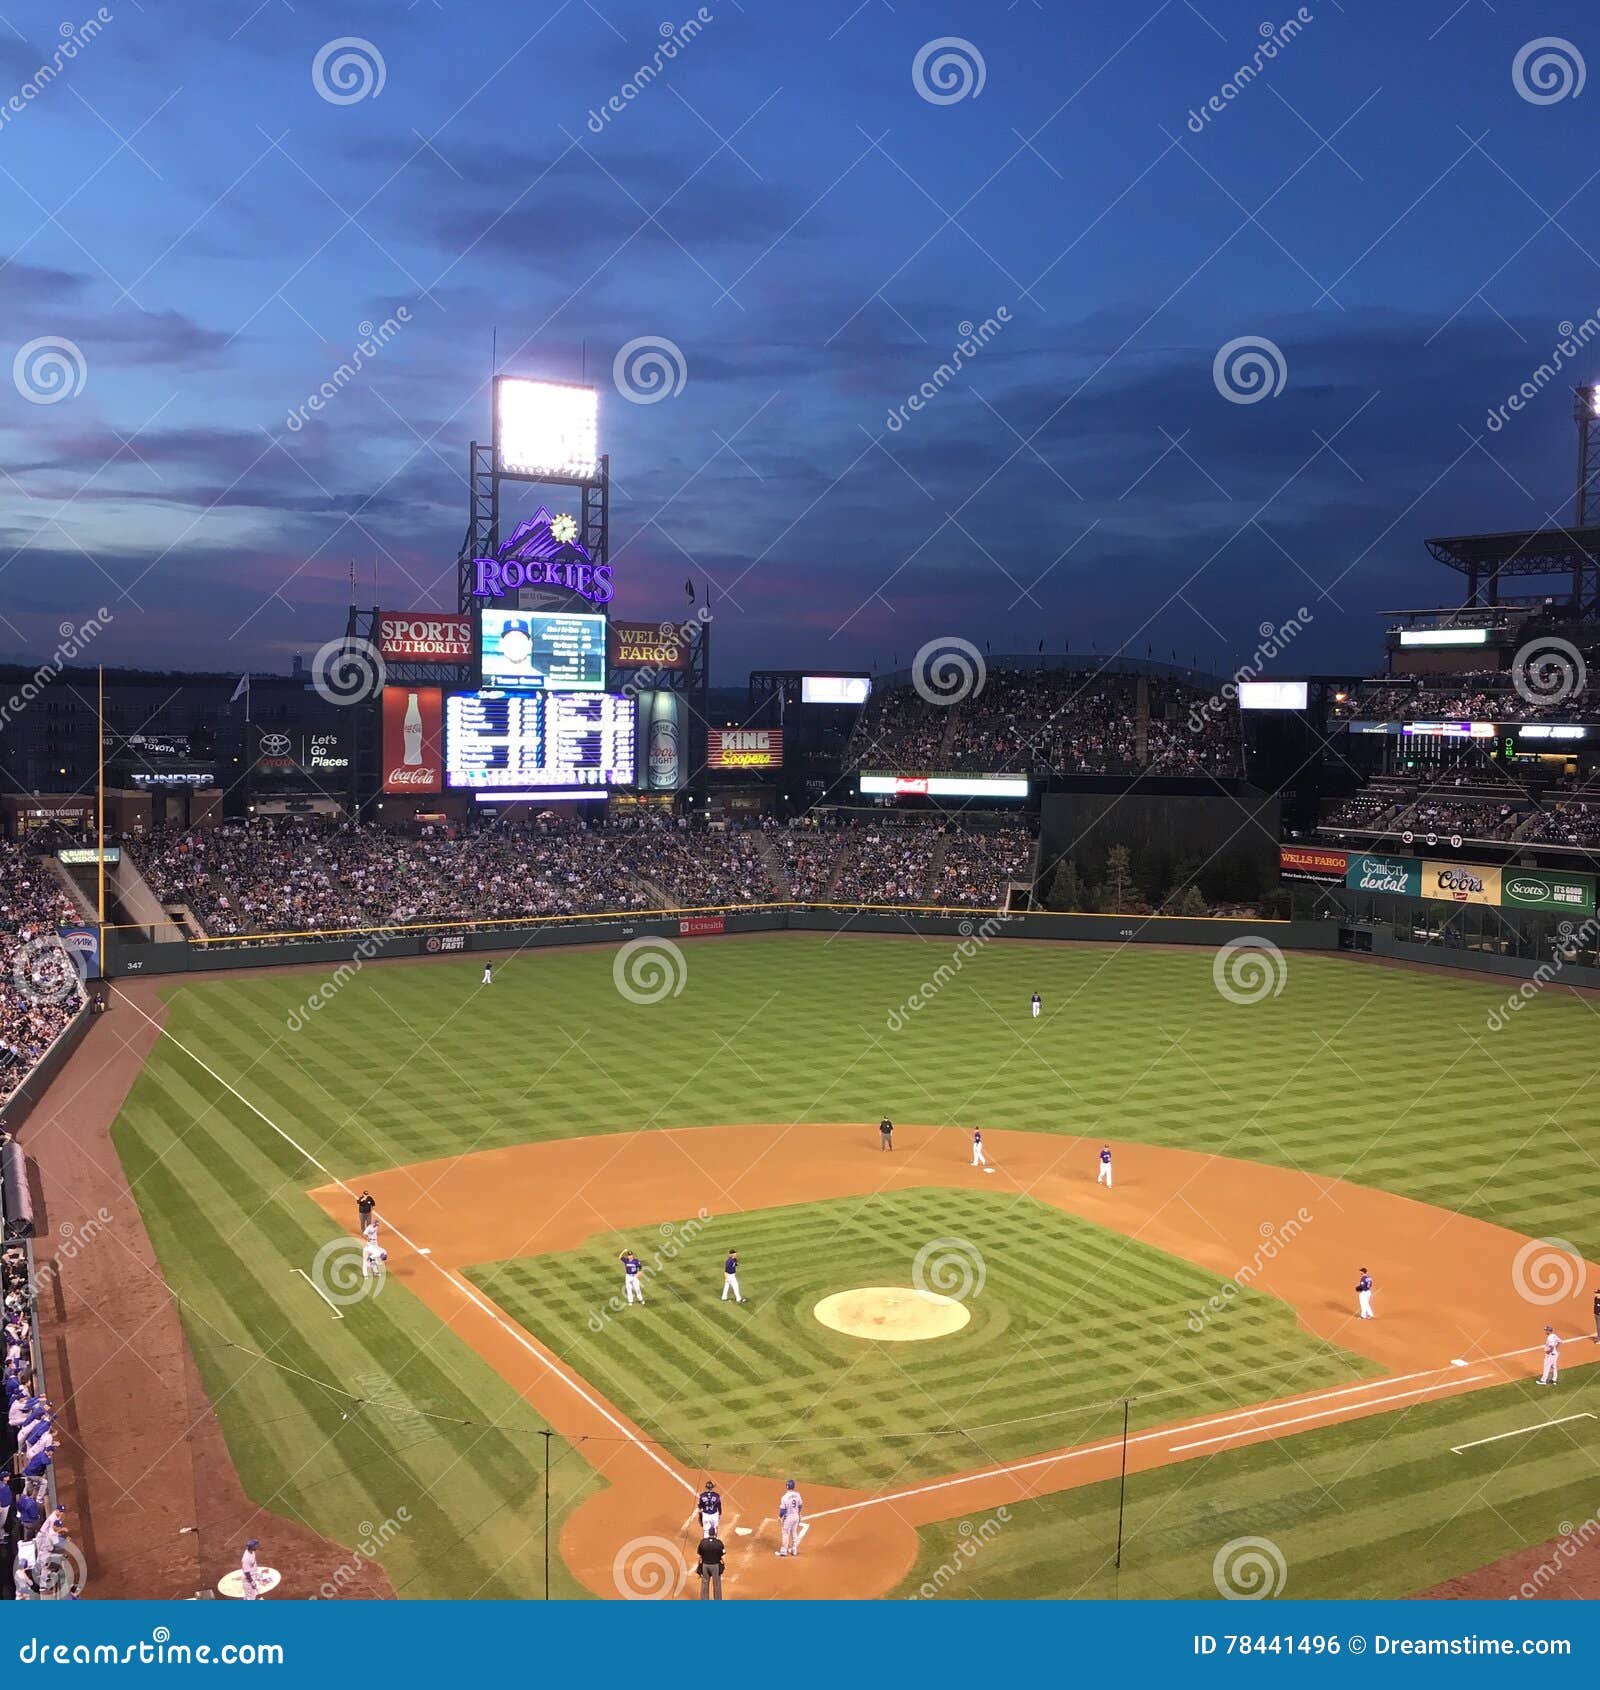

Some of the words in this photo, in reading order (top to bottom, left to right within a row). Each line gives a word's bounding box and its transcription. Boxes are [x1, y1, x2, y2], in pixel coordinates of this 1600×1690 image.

[472, 557, 616, 605] ROCKIES
[381, 620, 472, 642] SPORTS
[618, 630, 679, 646] WELLS
[381, 640, 470, 655] AUTHORITY
[618, 646, 678, 662] FARGO
[311, 734, 338, 745] Let's
[721, 732, 770, 750] KING
[143, 742, 176, 753] TOYOTA
[310, 745, 327, 756] Go
[311, 757, 350, 767] Places
[131, 774, 215, 784] TUNDRA
[26, 809, 55, 817] FRZEN
[1281, 853, 1313, 865] WELLS
[1313, 856, 1346, 868] FARGO
[1362, 858, 1404, 876] Comfort
[1359, 872, 1408, 893] dental
[1437, 869, 1485, 893] Coors
[127, 962, 143, 970] 347
